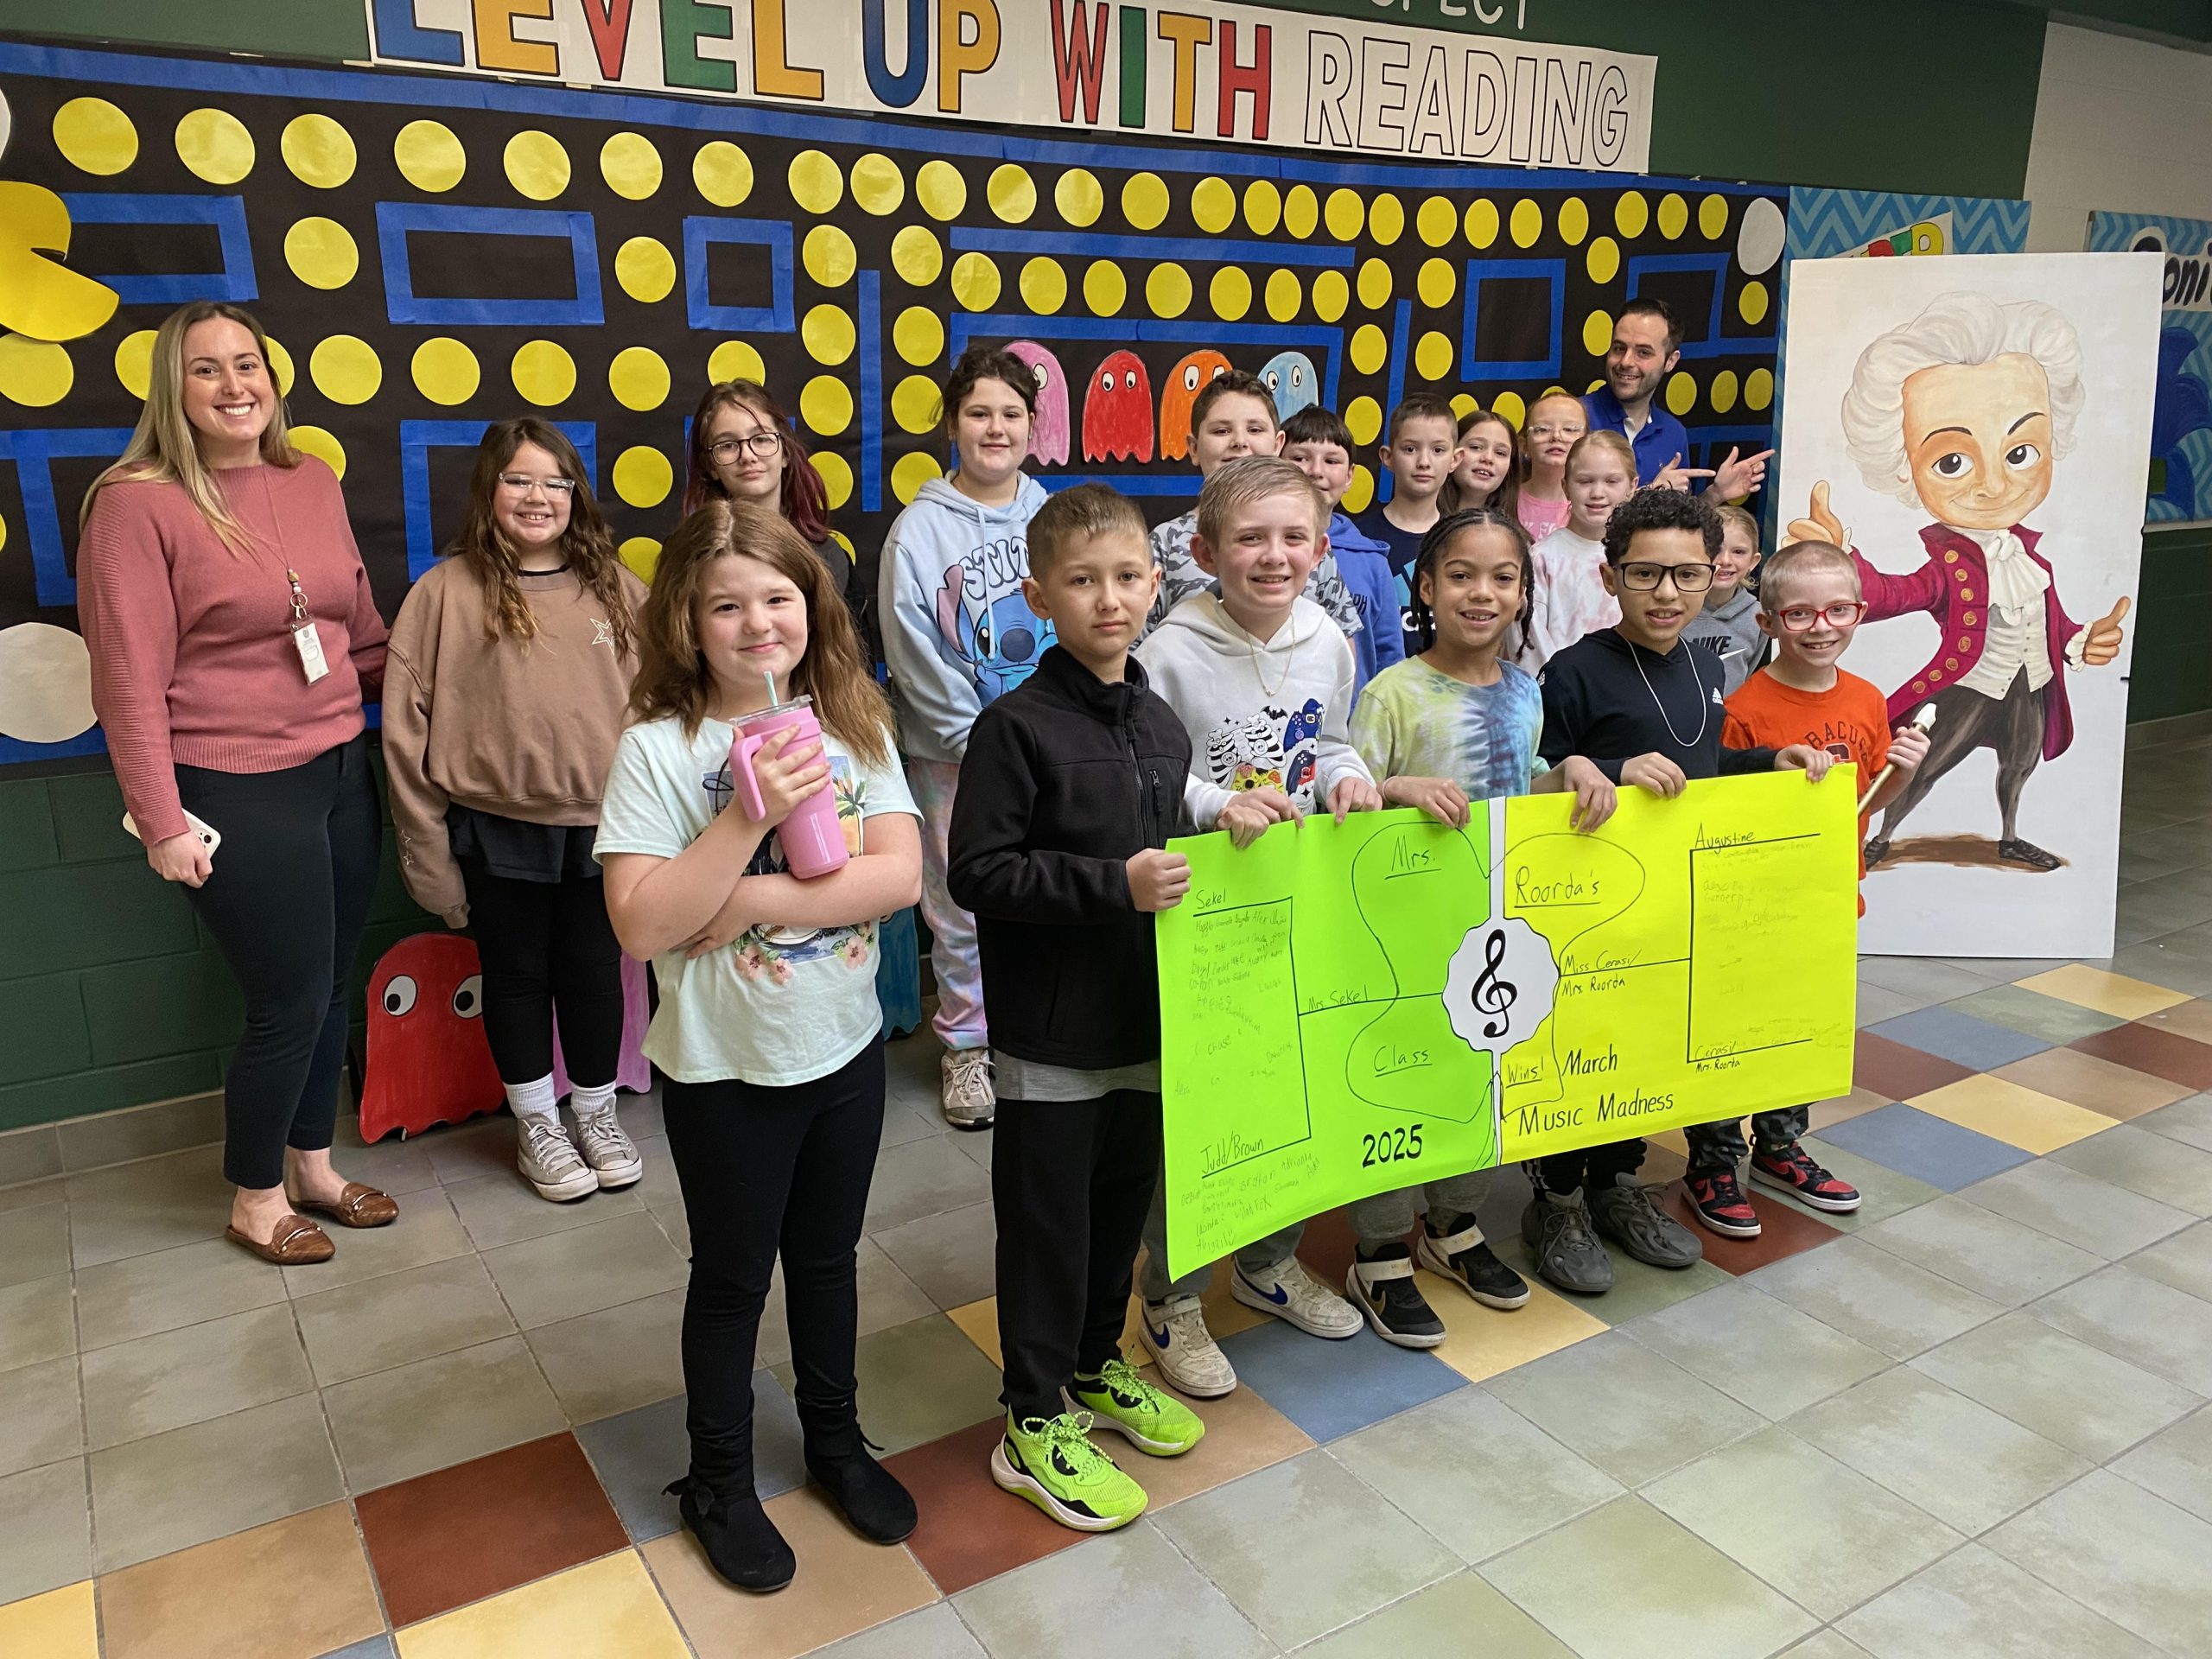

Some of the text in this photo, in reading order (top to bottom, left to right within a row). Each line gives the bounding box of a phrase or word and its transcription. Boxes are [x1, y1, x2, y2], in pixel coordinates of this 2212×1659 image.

[864, 0, 1002, 113] UP
[1051, 0, 1272, 141] WITH
[1304, 30, 1628, 167] READING
[1391, 835, 1436, 871] Mrs.
[1694, 822, 1756, 855] Augustine
[1196, 887, 1226, 910] Sekel
[1516, 866, 1599, 905] Roorda's
[1564, 954, 1590, 975] Miss
[1591, 975, 1625, 992] Roorda
[1374, 1045, 1430, 1072] Class
[1508, 1056, 1544, 1083] Wins!
[1561, 1043, 1618, 1077] March
[1714, 1057, 1740, 1071] Roorda
[1597, 1088, 1674, 1122] Madness
[1362, 1124, 1424, 1168] 2025
